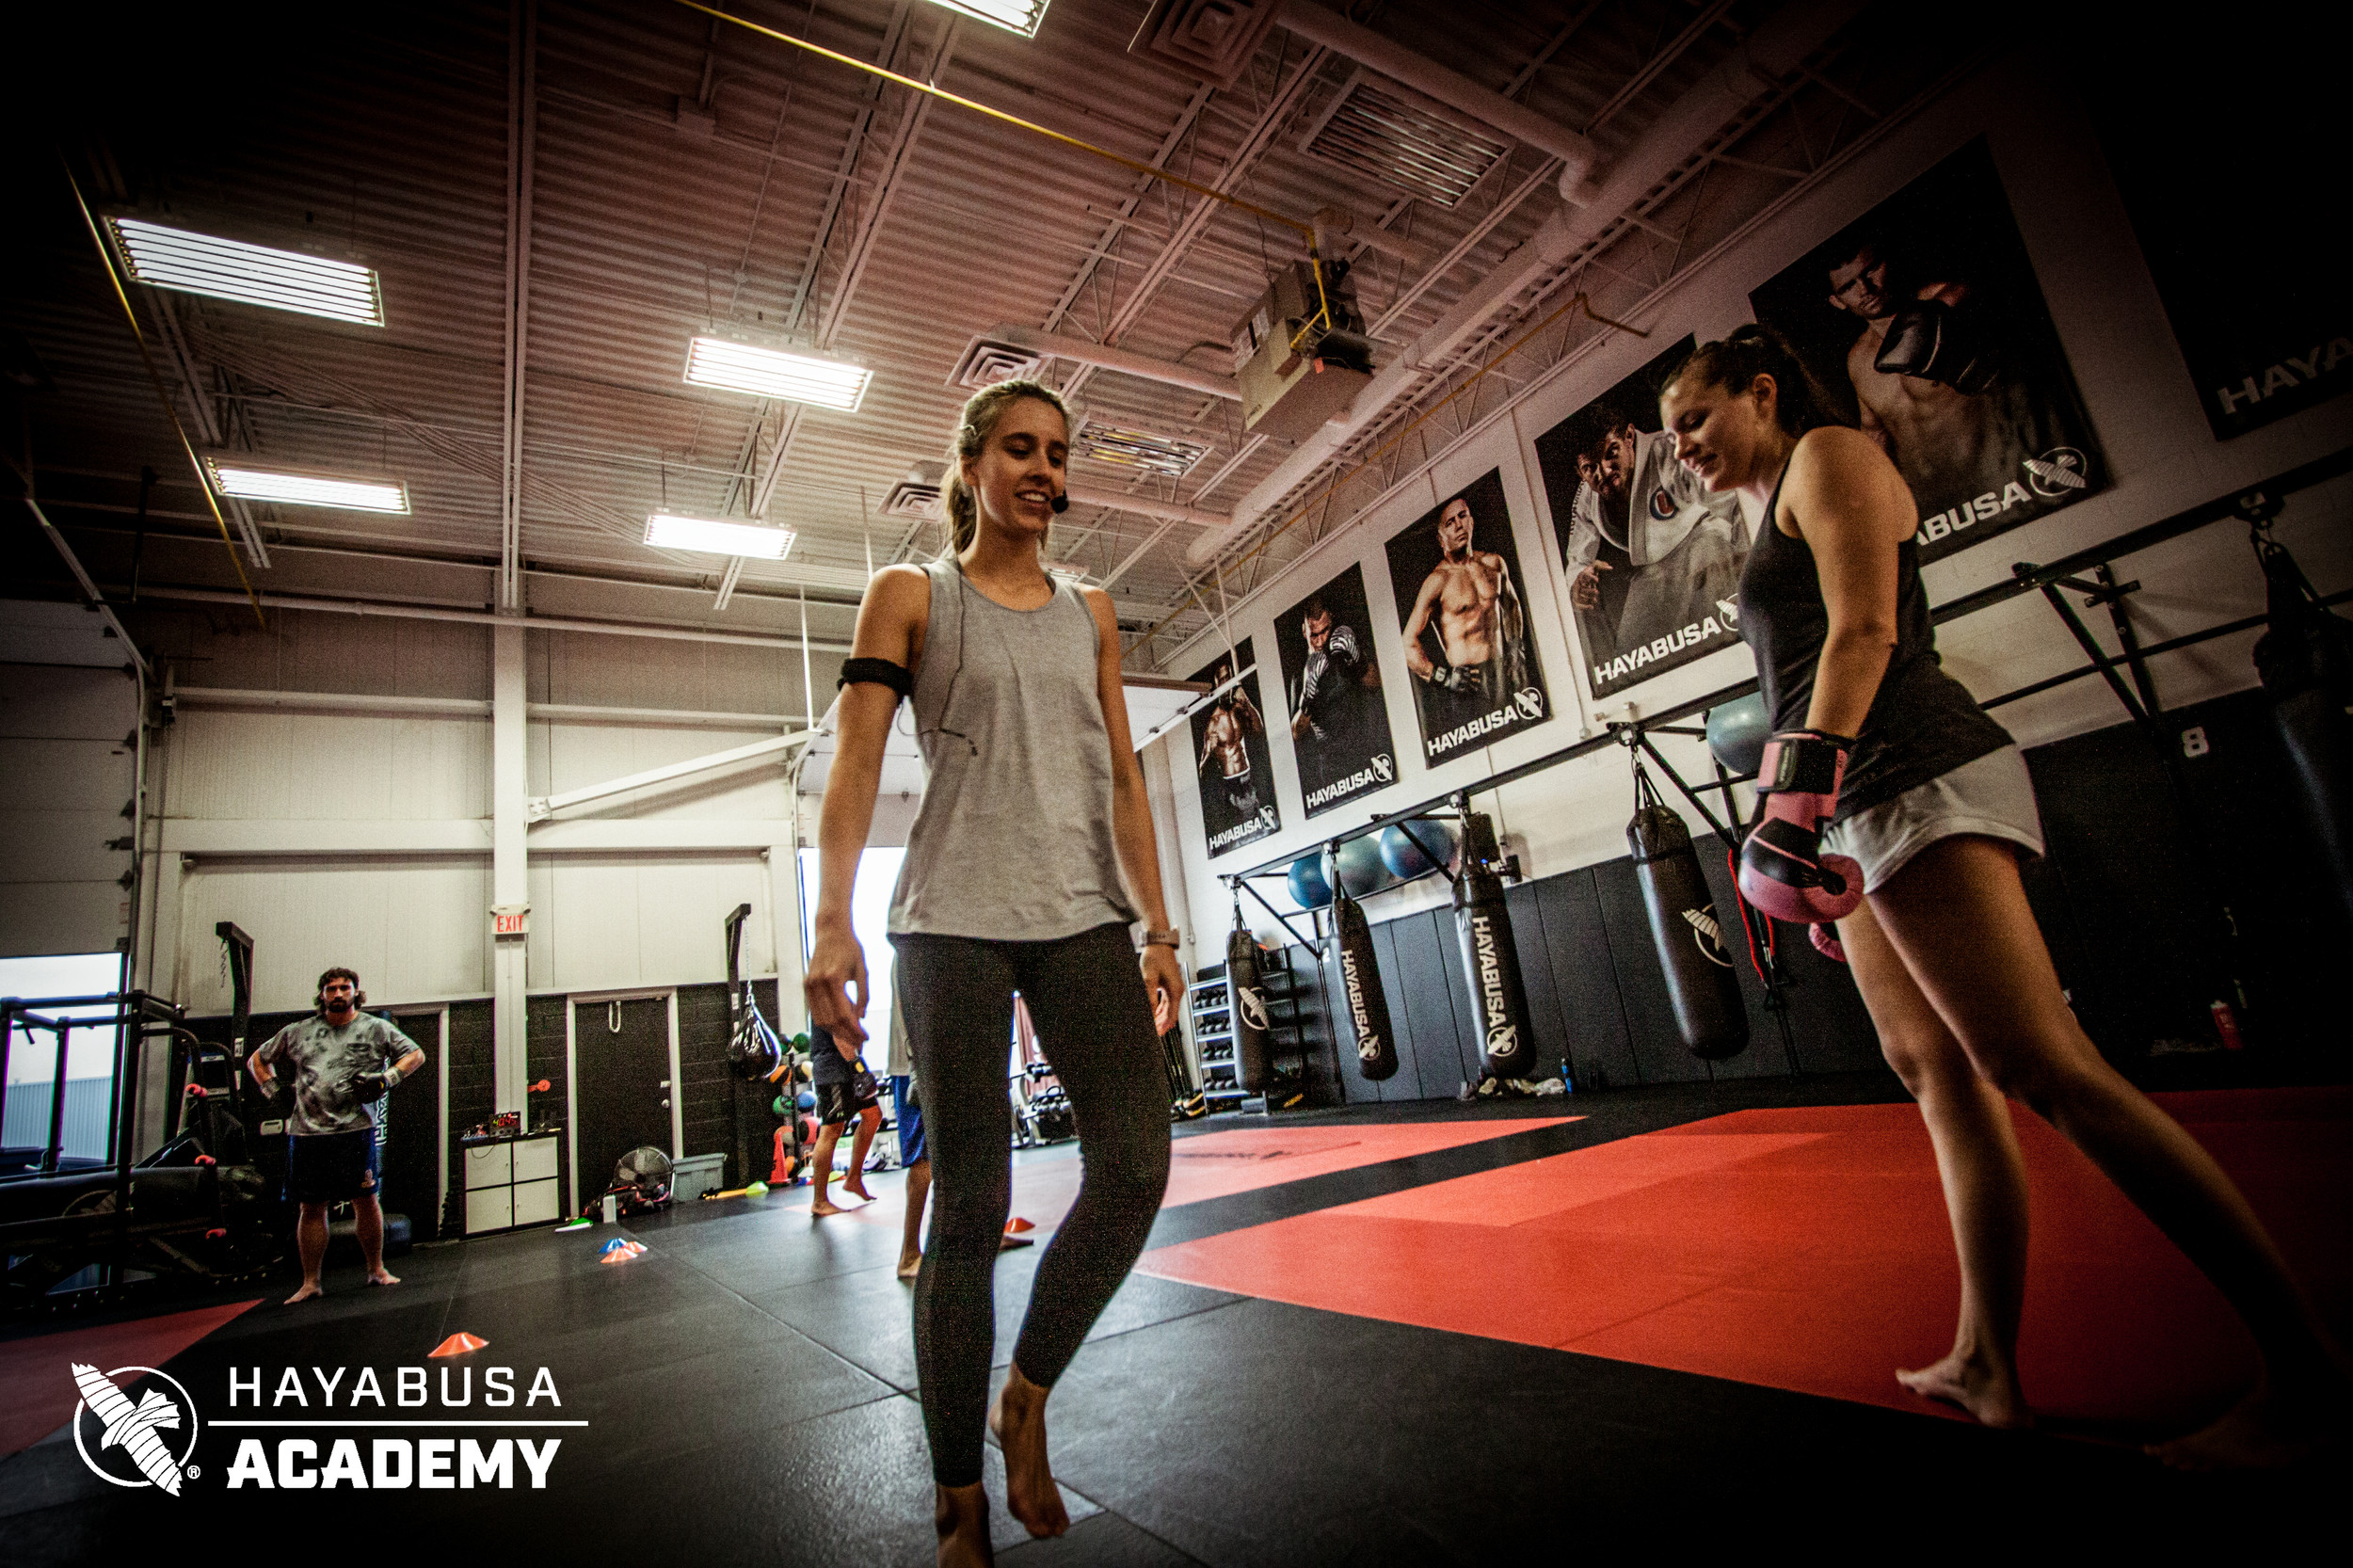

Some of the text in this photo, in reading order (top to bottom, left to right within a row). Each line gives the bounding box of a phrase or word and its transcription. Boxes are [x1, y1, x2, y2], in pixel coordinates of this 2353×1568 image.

[1594, 616, 1722, 685] HAYABUSA
[1427, 704, 1519, 757] HAYABUSA
[2181, 726, 2210, 759] 8
[1305, 768, 1375, 809] HAYABUSA
[1209, 816, 1262, 851] HAYABUSA
[497, 914, 524, 933] EXIT
[1340, 950, 1371, 1038] HAYABUSA
[1472, 916, 1508, 1029] HAYABUSA
